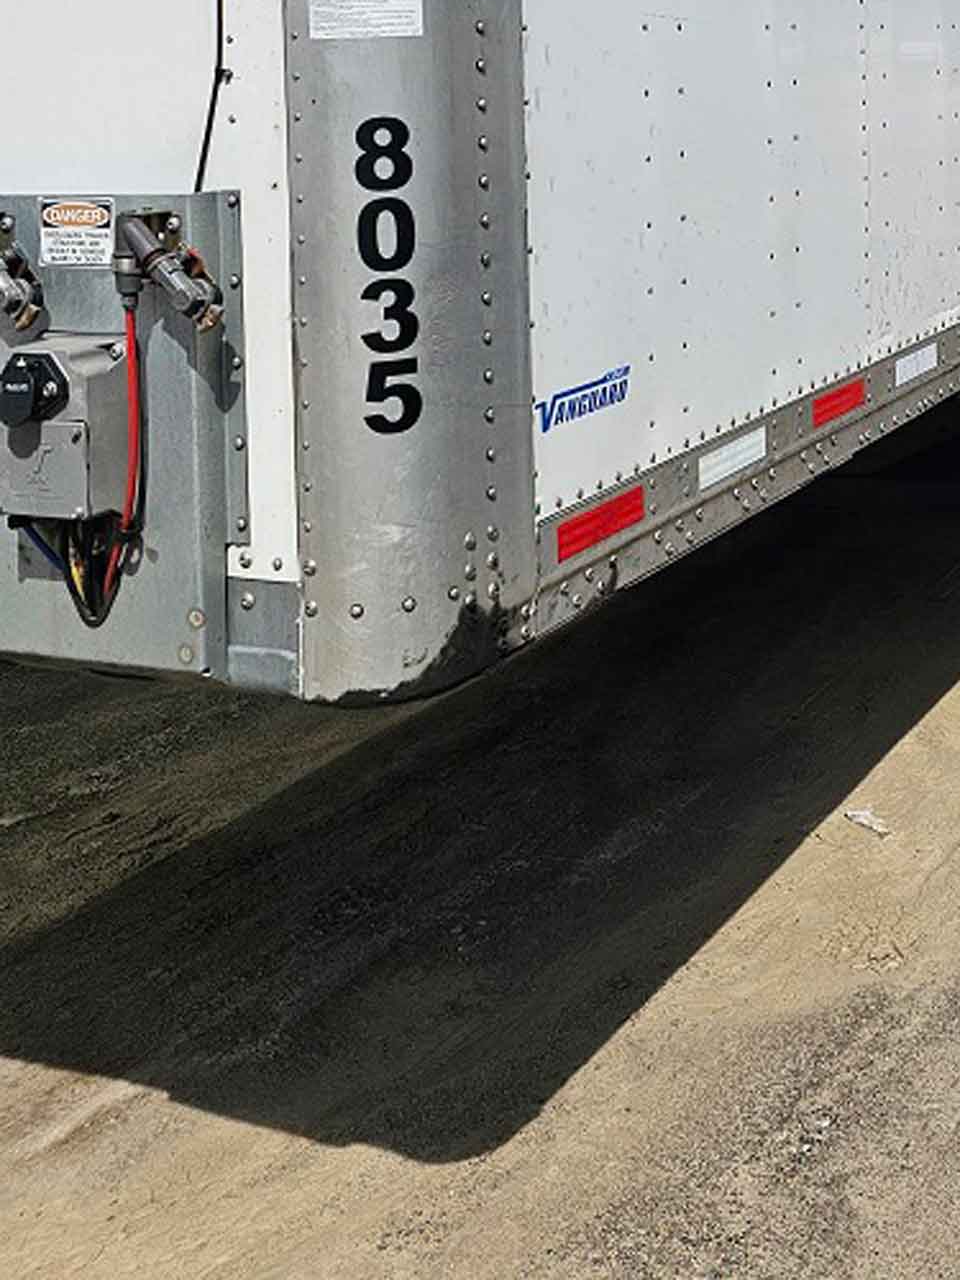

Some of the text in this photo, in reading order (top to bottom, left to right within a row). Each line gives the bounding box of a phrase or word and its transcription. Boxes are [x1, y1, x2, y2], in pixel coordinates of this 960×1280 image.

[49, 208, 104, 223] DANGER
[355, 117, 422, 435] 8035
[535, 378, 628, 433] VANGUARD
